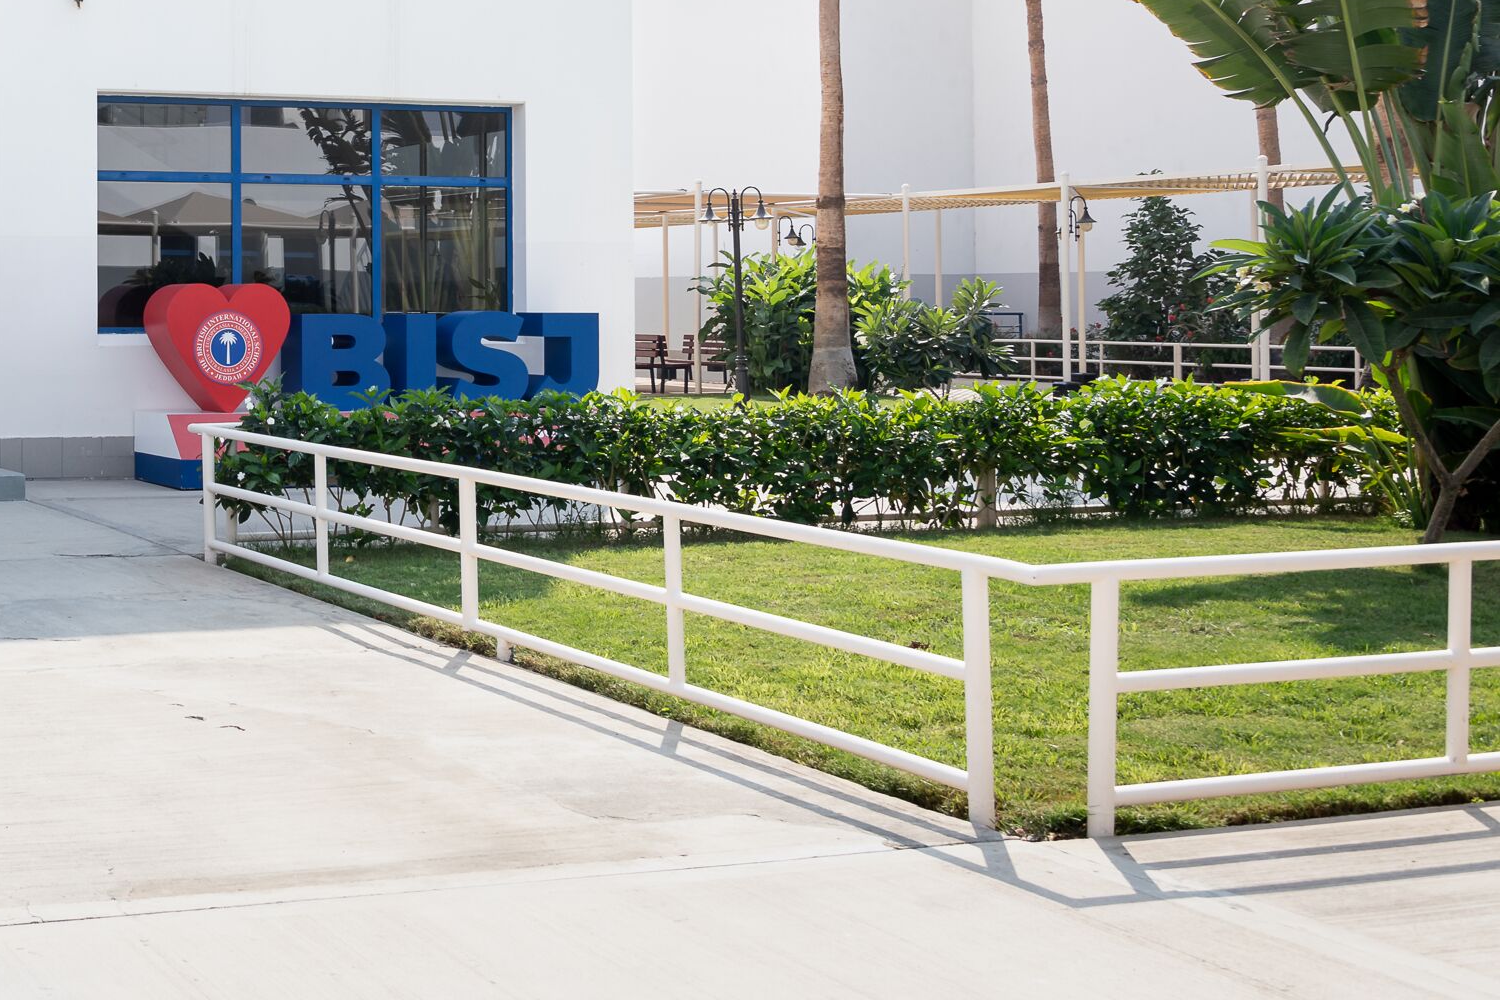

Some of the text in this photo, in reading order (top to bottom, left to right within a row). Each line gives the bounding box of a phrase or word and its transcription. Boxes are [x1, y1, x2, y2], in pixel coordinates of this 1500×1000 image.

[196, 313, 260, 372] THE BRITISH INTERNATIONAL SCHOOL
[298, 311, 600, 411] BISJ
[215, 373, 242, 381] JEDDAH
